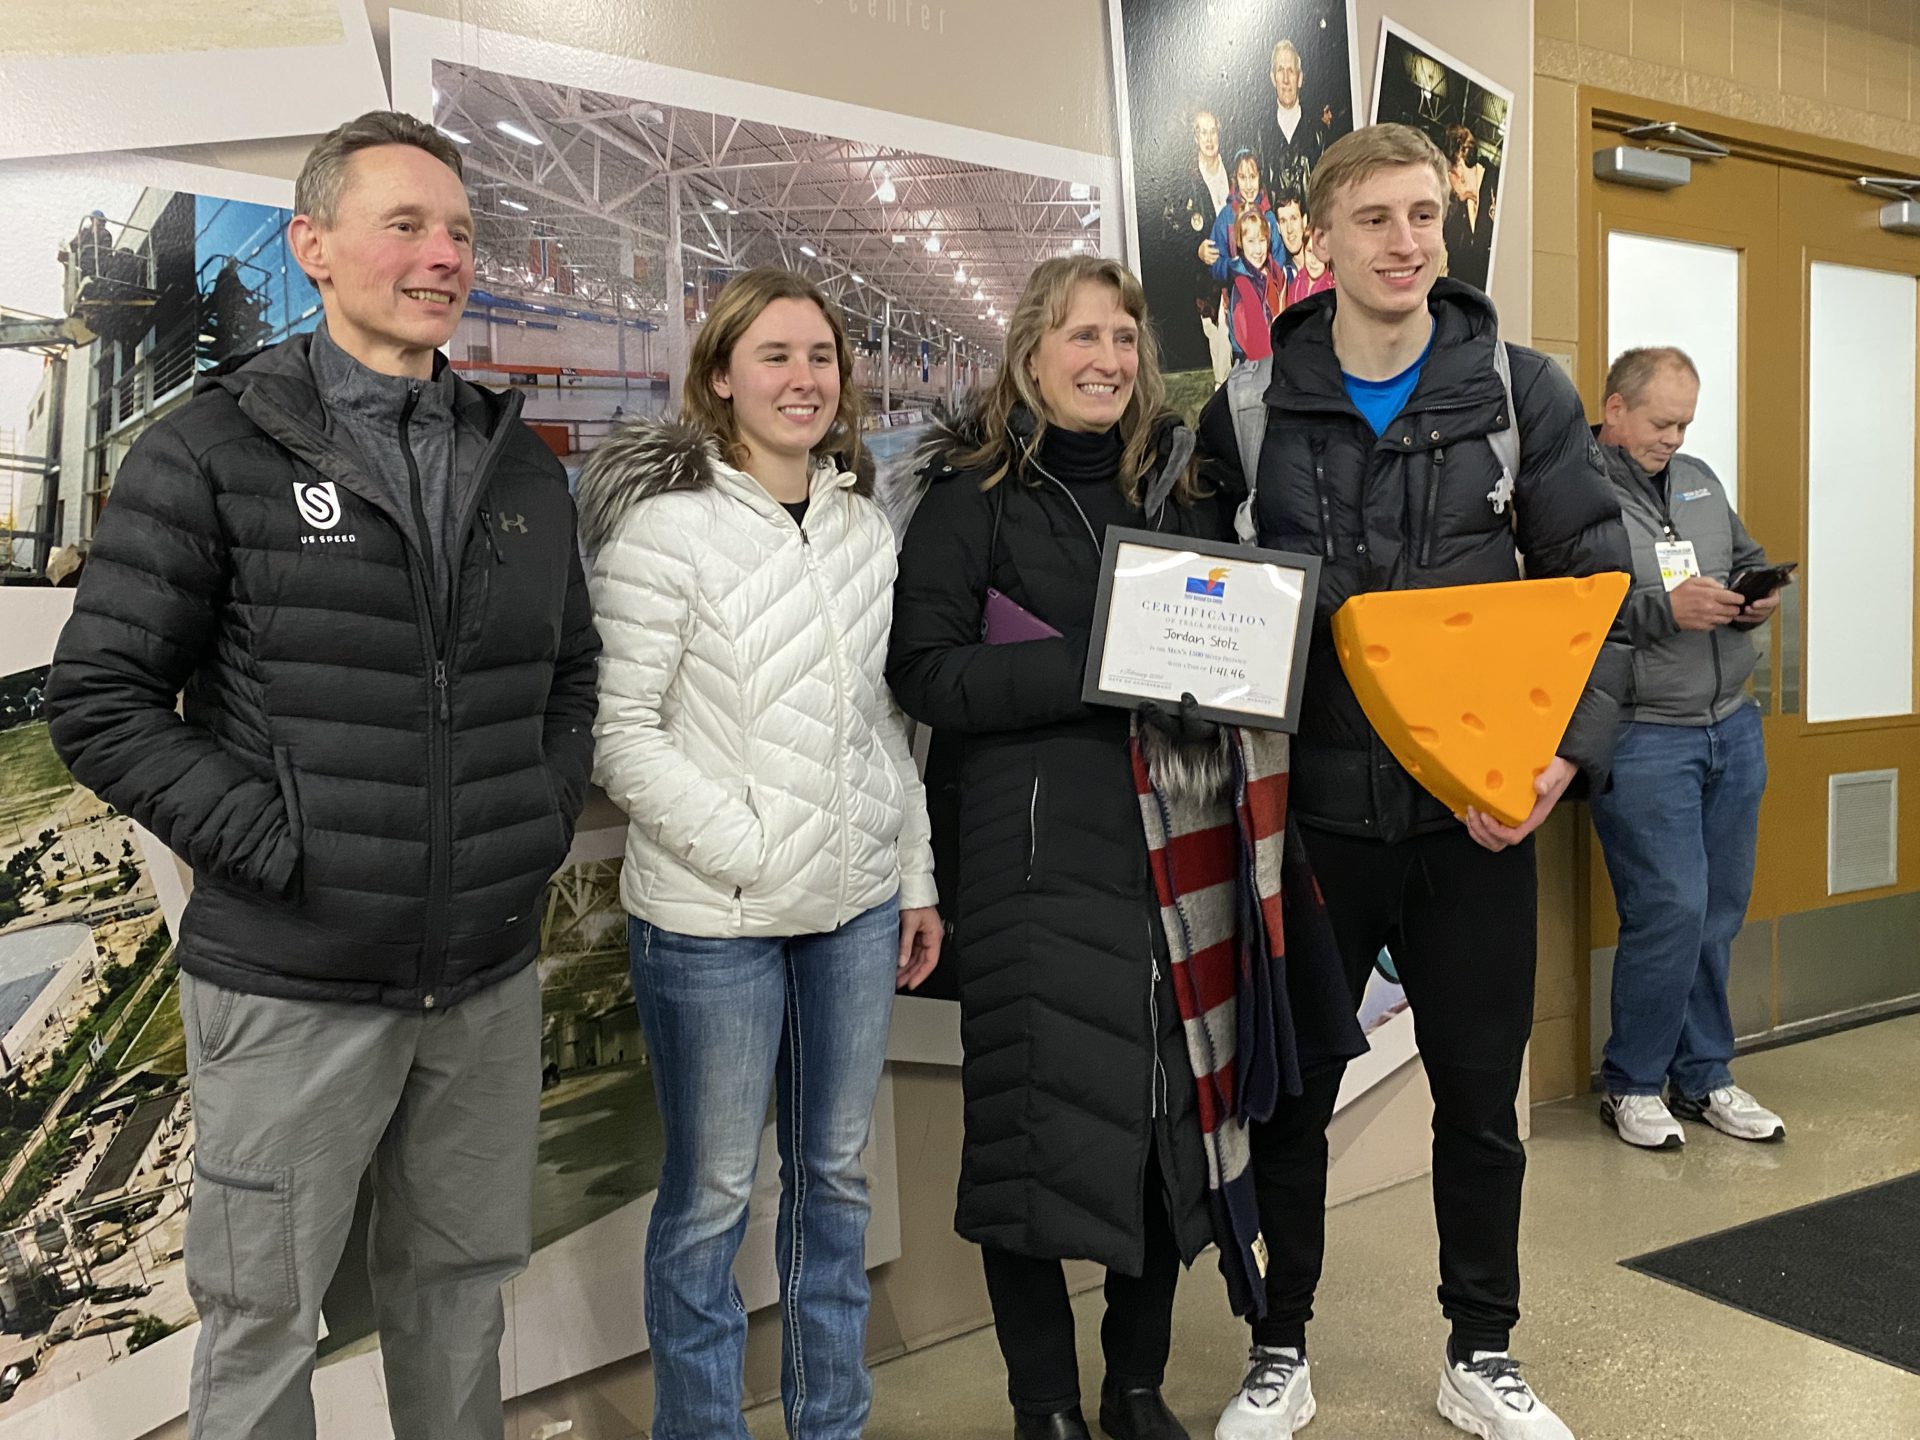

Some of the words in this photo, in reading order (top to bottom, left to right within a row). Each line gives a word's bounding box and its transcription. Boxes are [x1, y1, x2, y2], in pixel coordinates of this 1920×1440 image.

[300, 535, 315, 544] US
[319, 534, 356, 543] SPEED
[1142, 600, 1267, 627] CERTIFICATION
[1179, 619, 1204, 628] TRACK
[1207, 623, 1240, 633] RECORD
[1163, 628, 1205, 646] Jordan
[1210, 635, 1240, 651] Stolz
